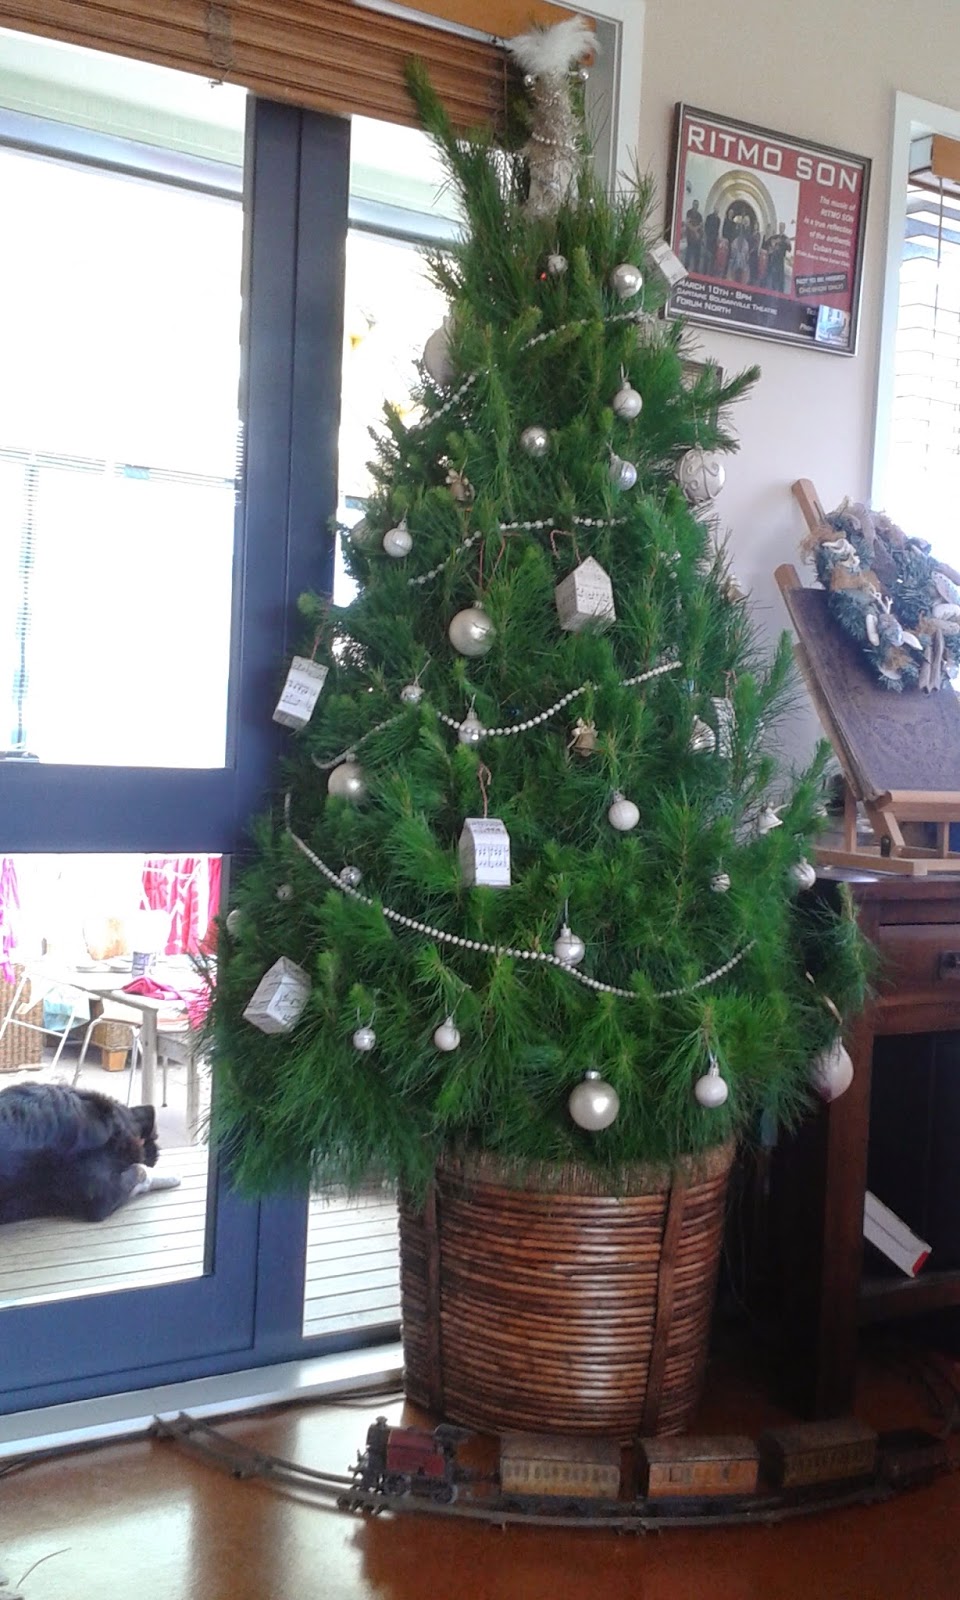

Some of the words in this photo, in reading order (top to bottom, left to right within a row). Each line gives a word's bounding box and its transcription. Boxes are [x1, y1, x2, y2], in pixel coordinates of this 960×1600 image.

[687, 124, 782, 172] RITMO
[796, 156, 857, 193] SON
[678, 279, 706, 291] MARCH
[708, 285, 729, 297] 10TH
[735, 290, 752, 301] 8PM
[676, 296, 702, 308] FORUM
[704, 302, 731, 314] NORTH
[751, 304, 778, 316] THEATRE
